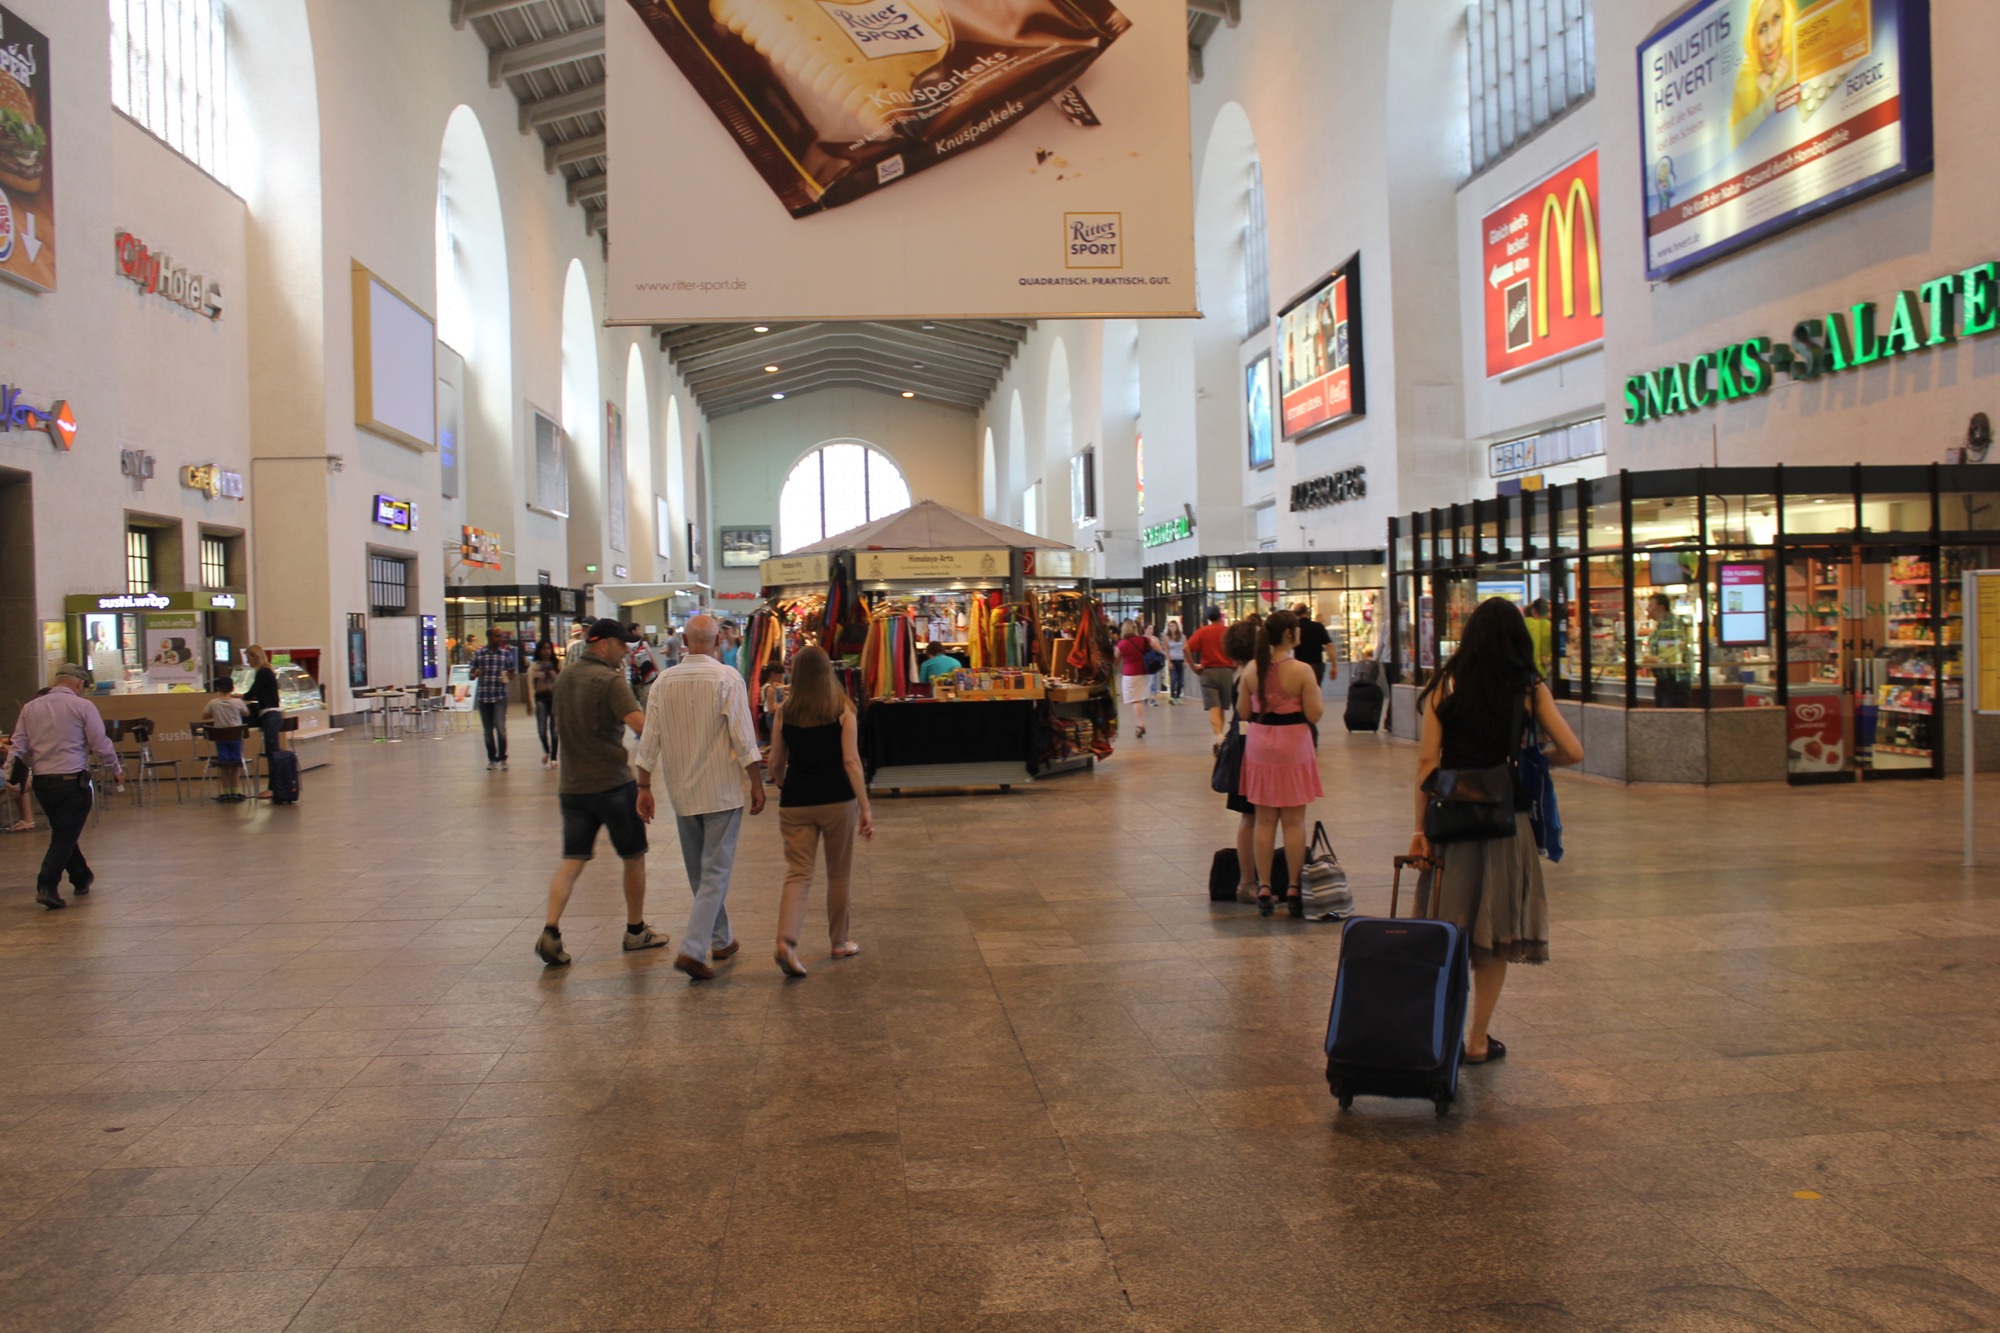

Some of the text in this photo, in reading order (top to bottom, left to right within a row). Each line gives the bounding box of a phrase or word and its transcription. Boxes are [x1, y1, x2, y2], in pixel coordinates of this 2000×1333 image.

[833, 4, 908, 30] Ritter
[855, 23, 925, 42] SPORT
[1653, 11, 1731, 82] SINUSITIS
[868, 50, 1008, 109] Knusperkeks
[1654, 55, 1716, 114] HEVERT
[934, 99, 1025, 155] Knusperkeks
[849, 139, 866, 151] mit
[1070, 221, 1117, 243] Ritter
[1071, 243, 1117, 255] SPORT
[635, 276, 748, 293] www.ritter-sport.de
[1018, 276, 1172, 286] QUADRATISCH. PRAKTISCH. GUT.
[1624, 337, 1771, 424] SNACKS
[1792, 260, 2000, 382] SALATE
[908, 554, 955, 563] Himalaya-Arts
[158, 730, 192, 742] sushi
